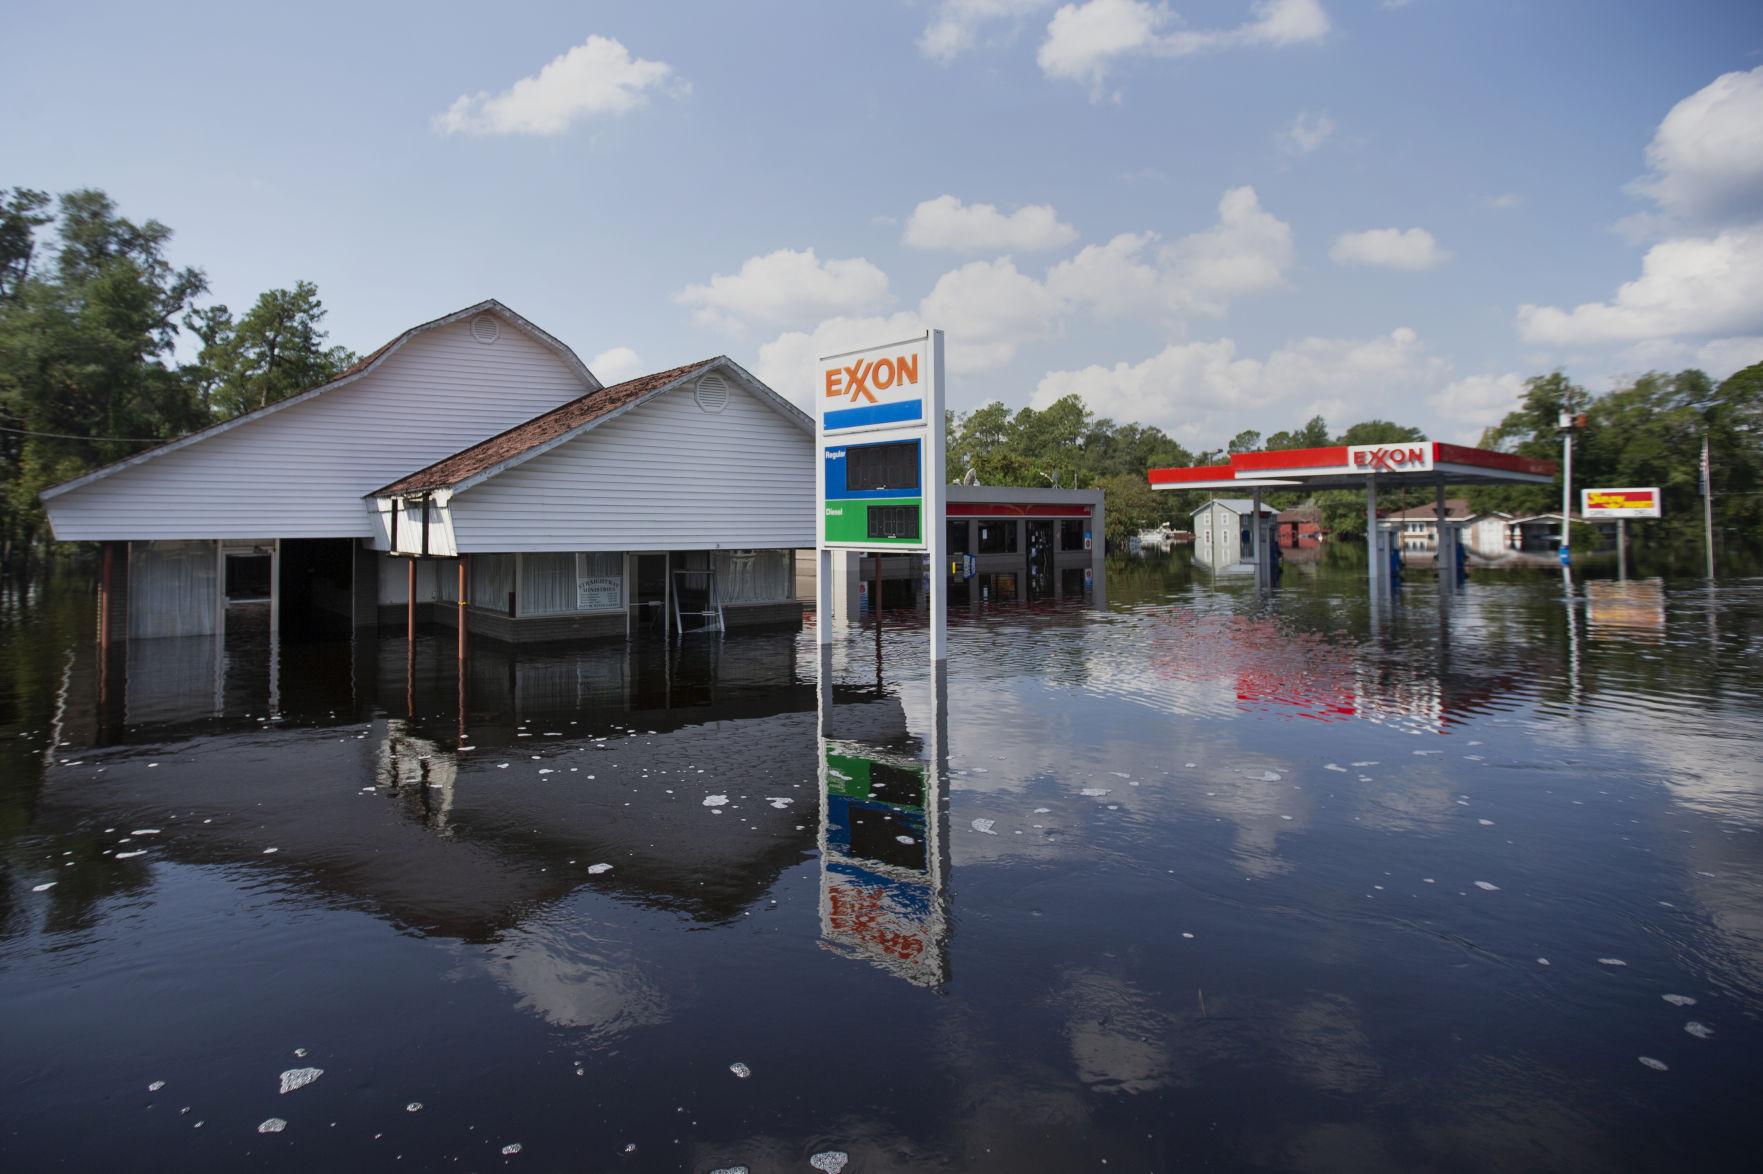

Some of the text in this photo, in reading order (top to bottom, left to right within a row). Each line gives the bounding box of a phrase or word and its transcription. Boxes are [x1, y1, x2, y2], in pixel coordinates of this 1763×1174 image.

[825, 353, 918, 403] EXXON
[825, 450, 846, 460] Regular
[1353, 447, 1423, 472] EXXON
[825, 507, 843, 516] Diesel
